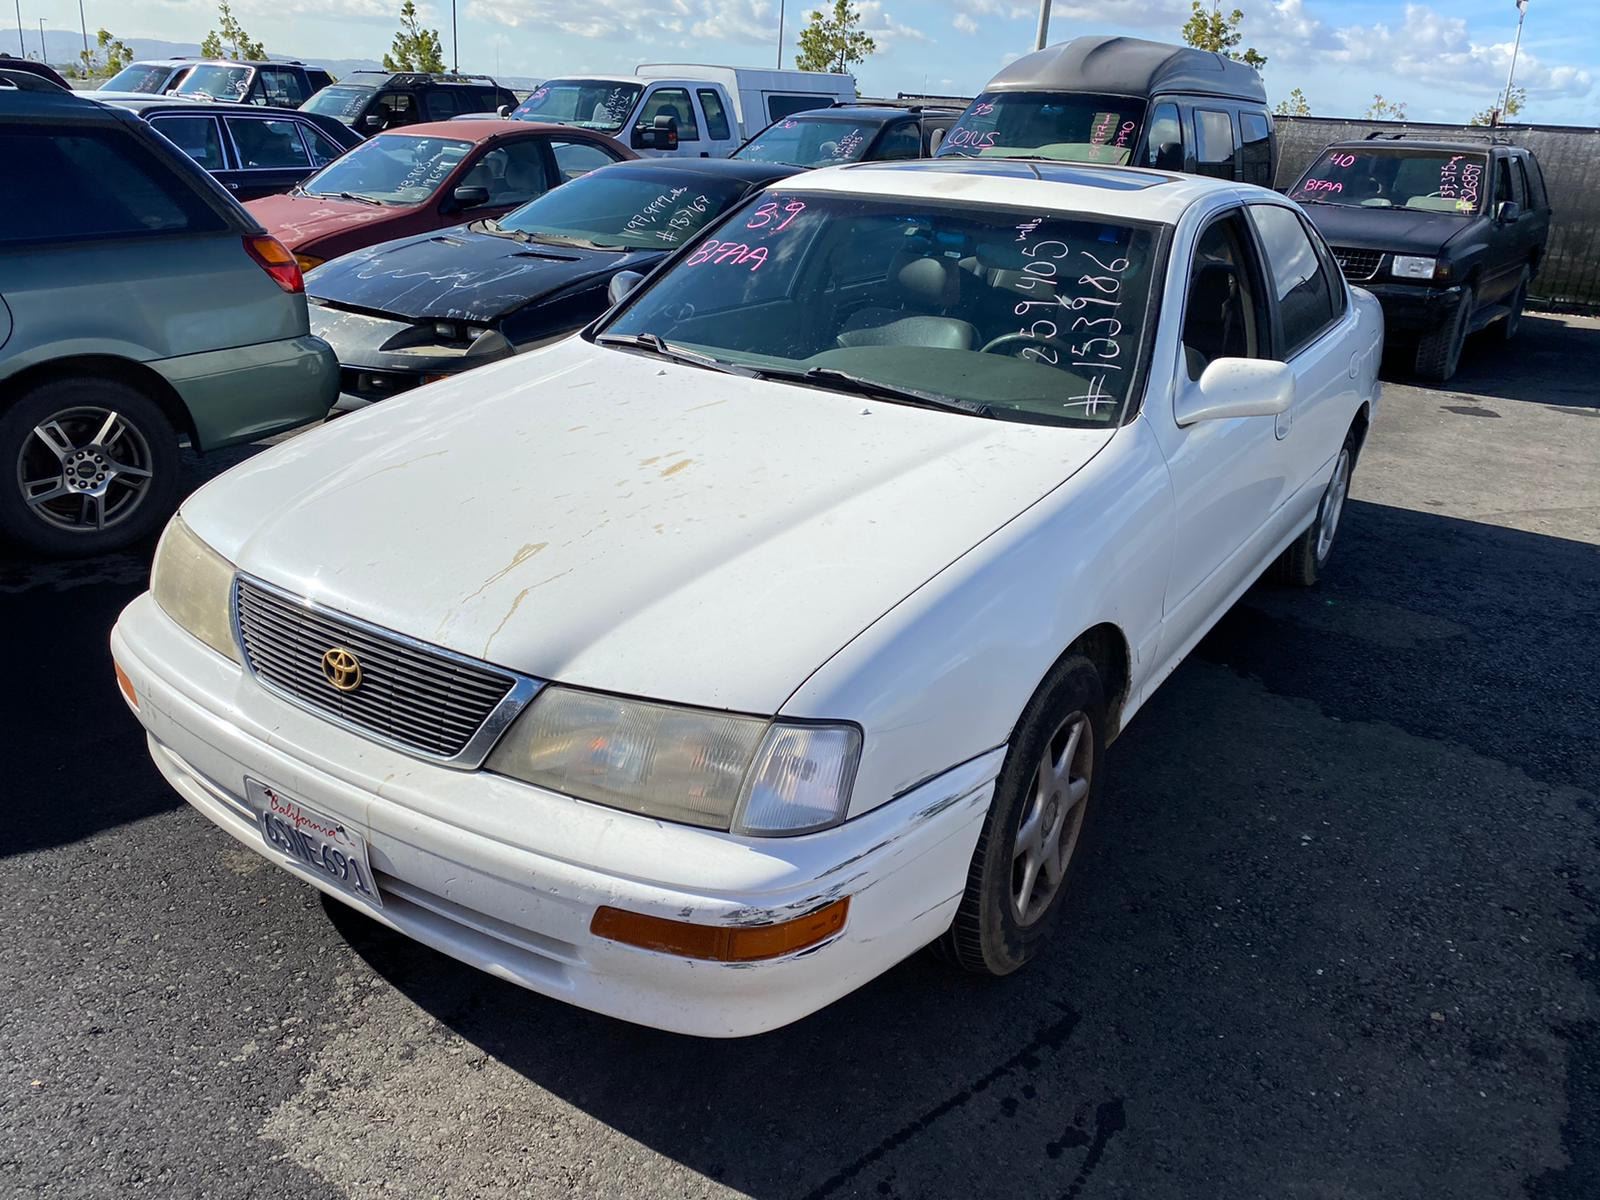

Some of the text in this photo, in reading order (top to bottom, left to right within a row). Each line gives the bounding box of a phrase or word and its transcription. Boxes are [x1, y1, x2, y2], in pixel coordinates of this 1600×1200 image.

[970, 103, 994, 116] 35
[947, 127, 1000, 148] CONS
[1330, 153, 1355, 168] 40
[1304, 178, 1343, 193] BFAA
[623, 194, 673, 235] 197,999
[746, 202, 807, 231] 39
[686, 240, 769, 271] BFAA
[1014, 240, 1071, 364] 259,405
[1063, 251, 1130, 416] #153986
[270, 794, 345, 846] California
